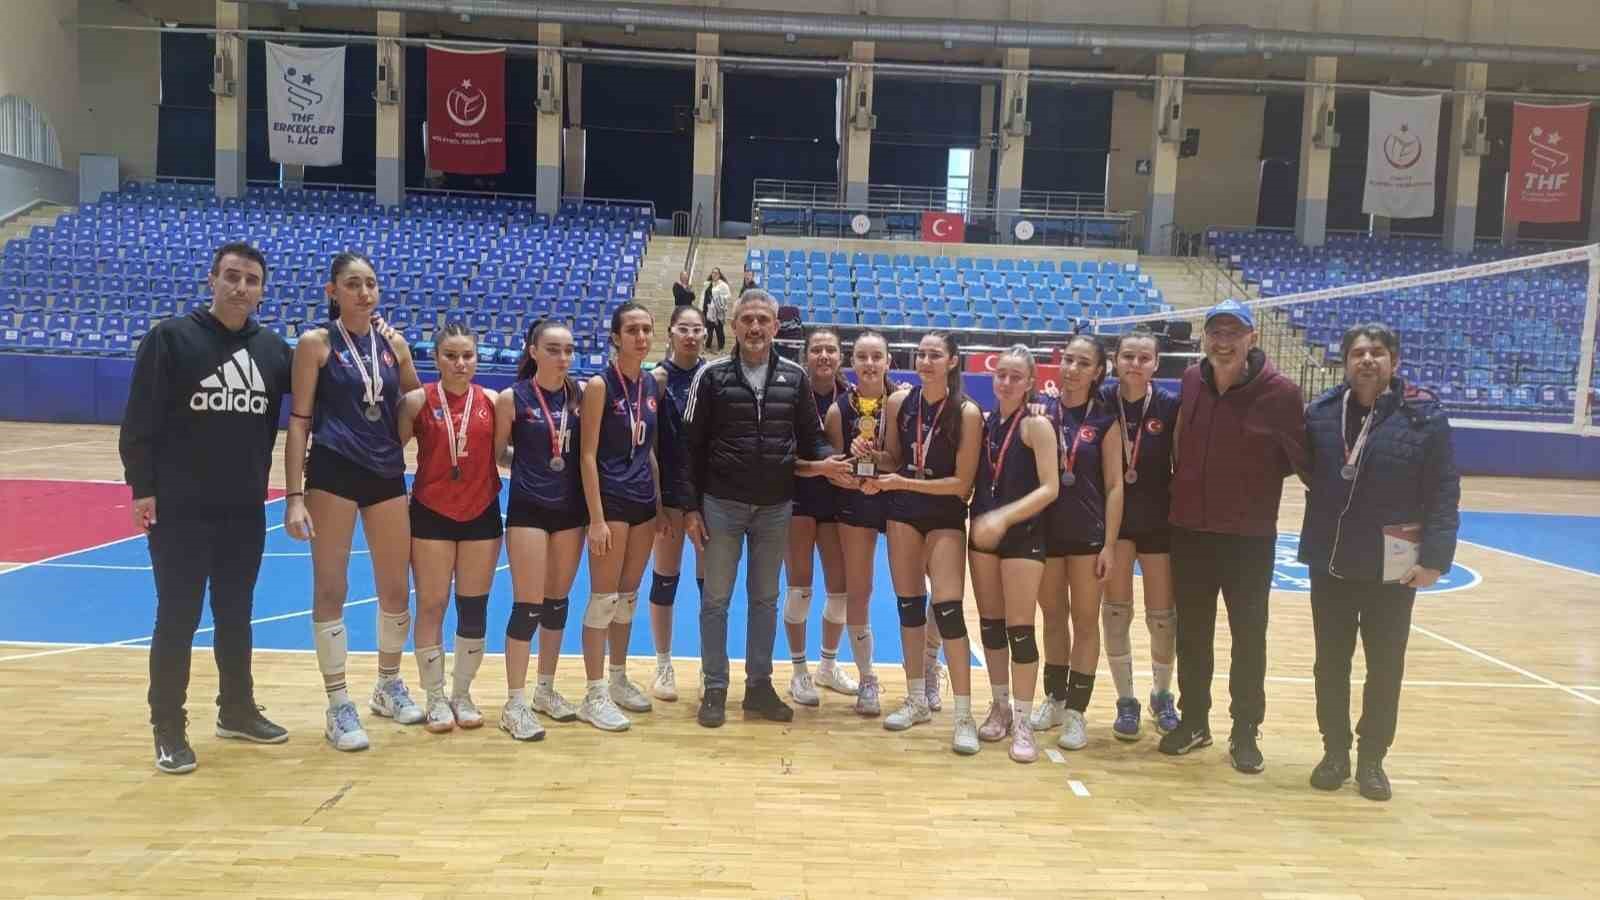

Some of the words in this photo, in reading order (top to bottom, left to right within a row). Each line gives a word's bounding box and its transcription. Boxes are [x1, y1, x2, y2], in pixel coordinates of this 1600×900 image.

[291, 113, 315, 122] THF
[273, 122, 335, 135] ERKEKLER
[1524, 172, 1570, 190] THF
